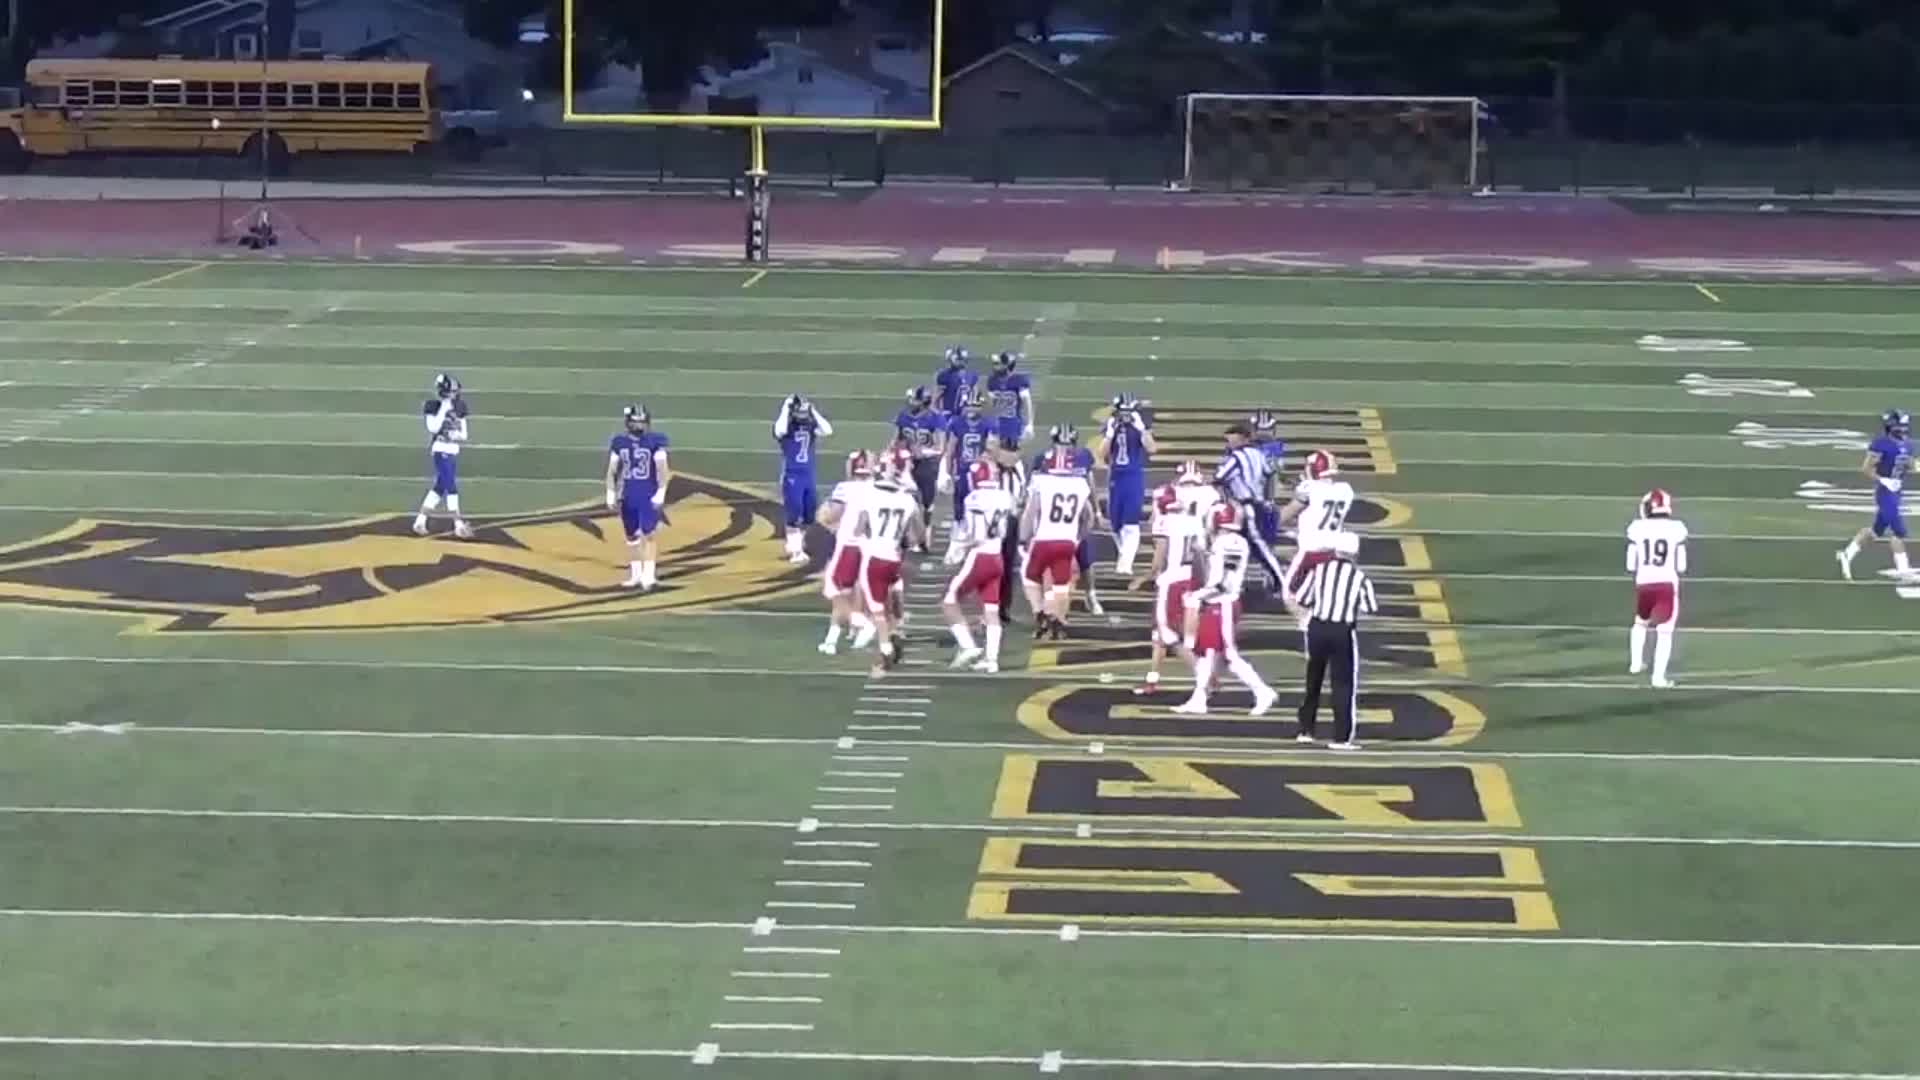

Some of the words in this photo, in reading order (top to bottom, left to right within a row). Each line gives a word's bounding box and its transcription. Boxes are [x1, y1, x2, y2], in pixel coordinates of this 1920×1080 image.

[397, 240, 1920, 274] OSHKOS
[621, 447, 653, 480] 13
[794, 431, 810, 464] 7
[1116, 433, 1130, 466] 1
[877, 507, 906, 540] 77
[1049, 493, 1078, 524] 63
[1319, 499, 1346, 531] 75
[1642, 539, 1669, 567] 19
